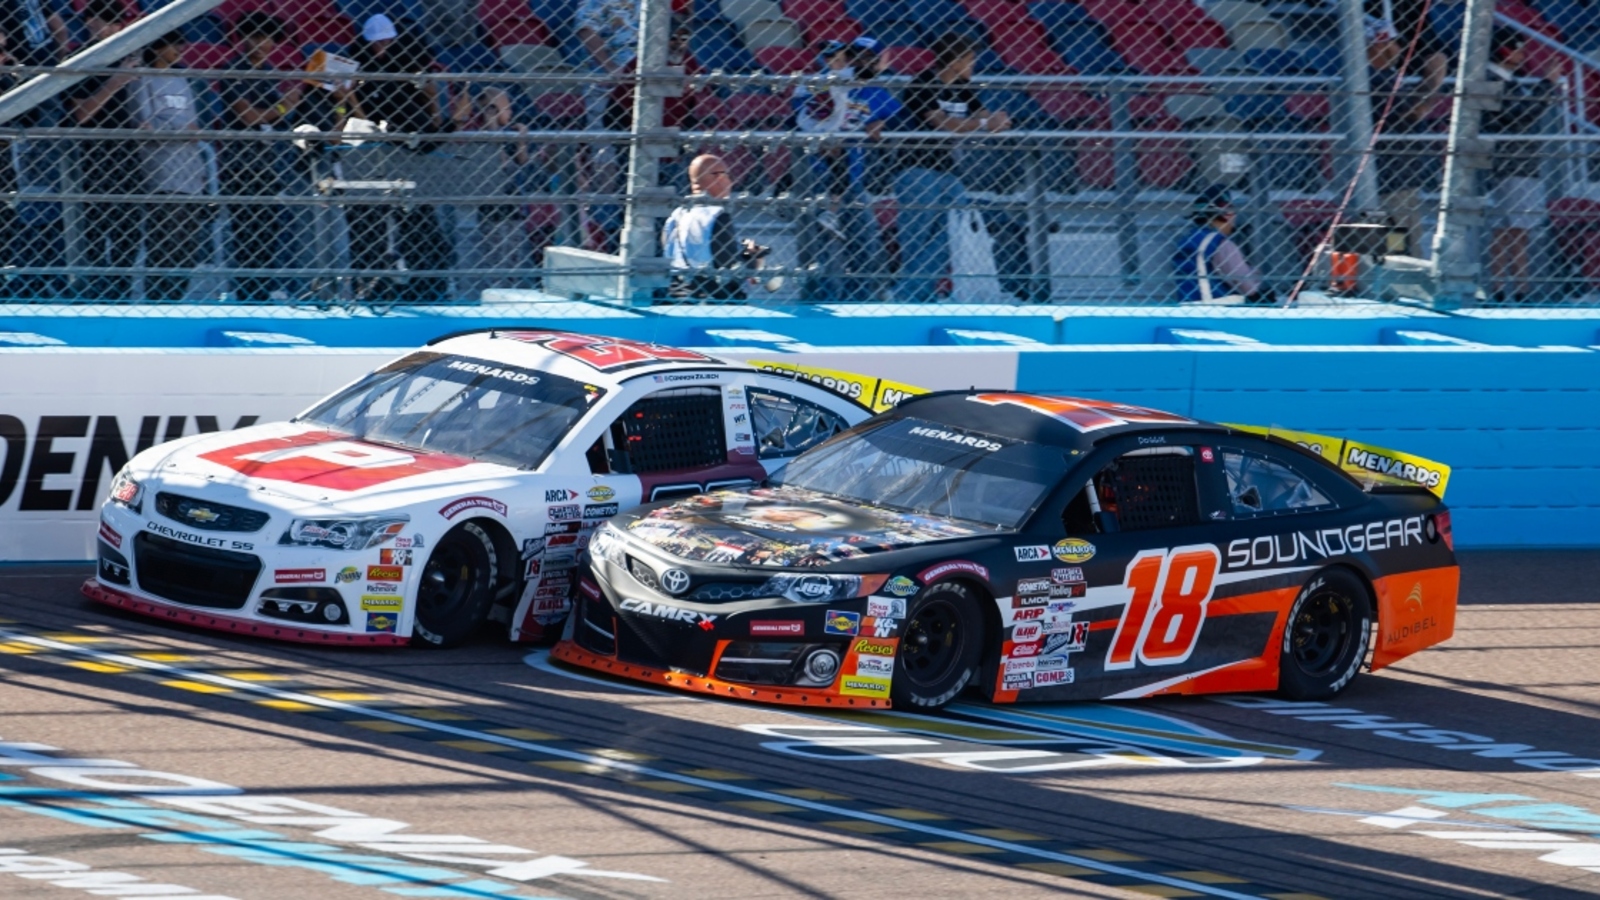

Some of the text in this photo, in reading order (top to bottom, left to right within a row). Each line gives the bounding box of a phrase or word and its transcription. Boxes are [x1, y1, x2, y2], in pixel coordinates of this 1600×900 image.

[447, 359, 541, 386] MENARDS
[908, 426, 1002, 452] MENARDS
[1347, 448, 1441, 487] MENARDS
[545, 489, 568, 502] ARCA
[443, 499, 476, 518] GENERAL
[147, 520, 227, 547] CHEVROLET
[1228, 515, 1424, 568] SOUNDGEAR
[1018, 547, 1039, 559] ARCA
[1051, 543, 1096, 554] MENARDS
[923, 563, 957, 581] GENERAL
[794, 582, 834, 596] JGR
[884, 578, 920, 596] Bounty
[1050, 584, 1072, 597] Holley
[619, 598, 718, 623] CAMRY
[868, 609, 887, 618] Chief
[869, 602, 890, 610] Sioux
[1013, 608, 1045, 621] ARP
[1104, 542, 1222, 672] 18
[1386, 615, 1437, 644] AUDIBEL
[854, 639, 894, 655] Reese's
[1036, 671, 1065, 683] COMP
